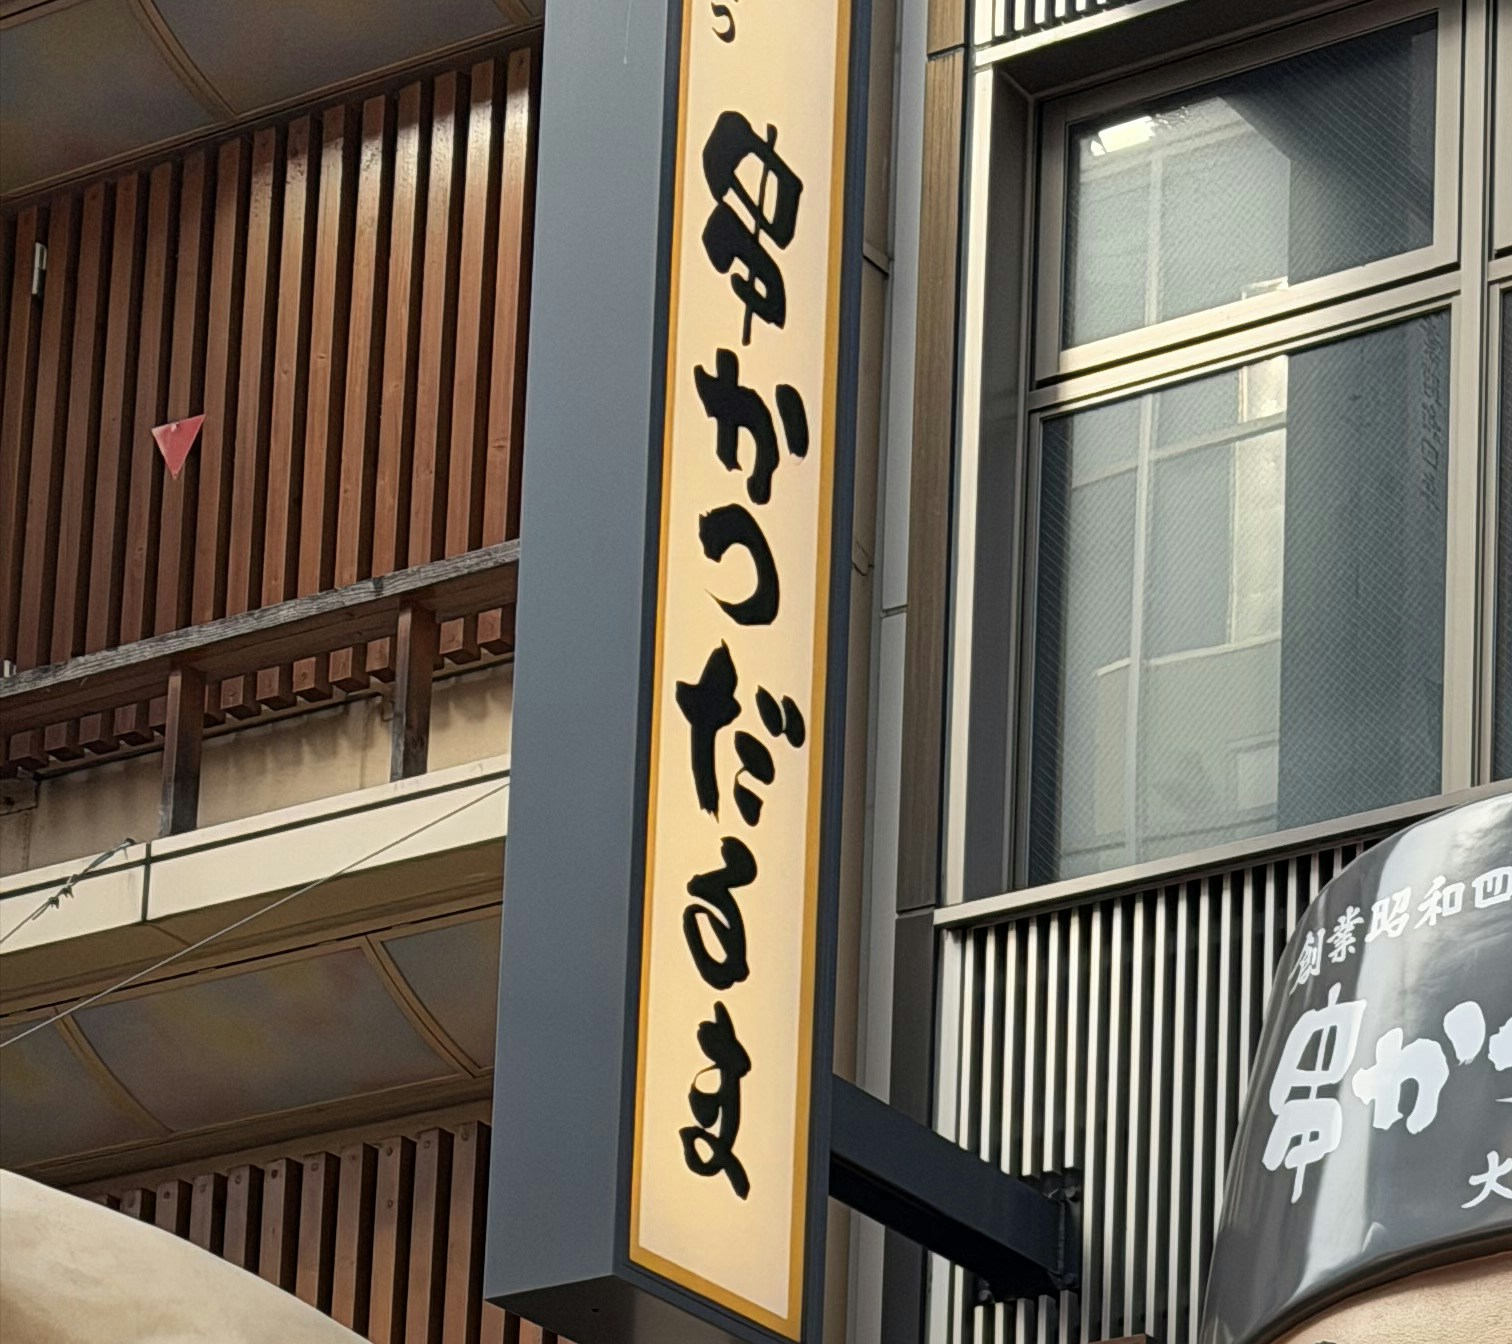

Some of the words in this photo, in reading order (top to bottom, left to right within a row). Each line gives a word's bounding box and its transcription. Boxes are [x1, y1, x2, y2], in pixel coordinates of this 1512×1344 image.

[676, 109, 809, 1199] 串かつだるま
